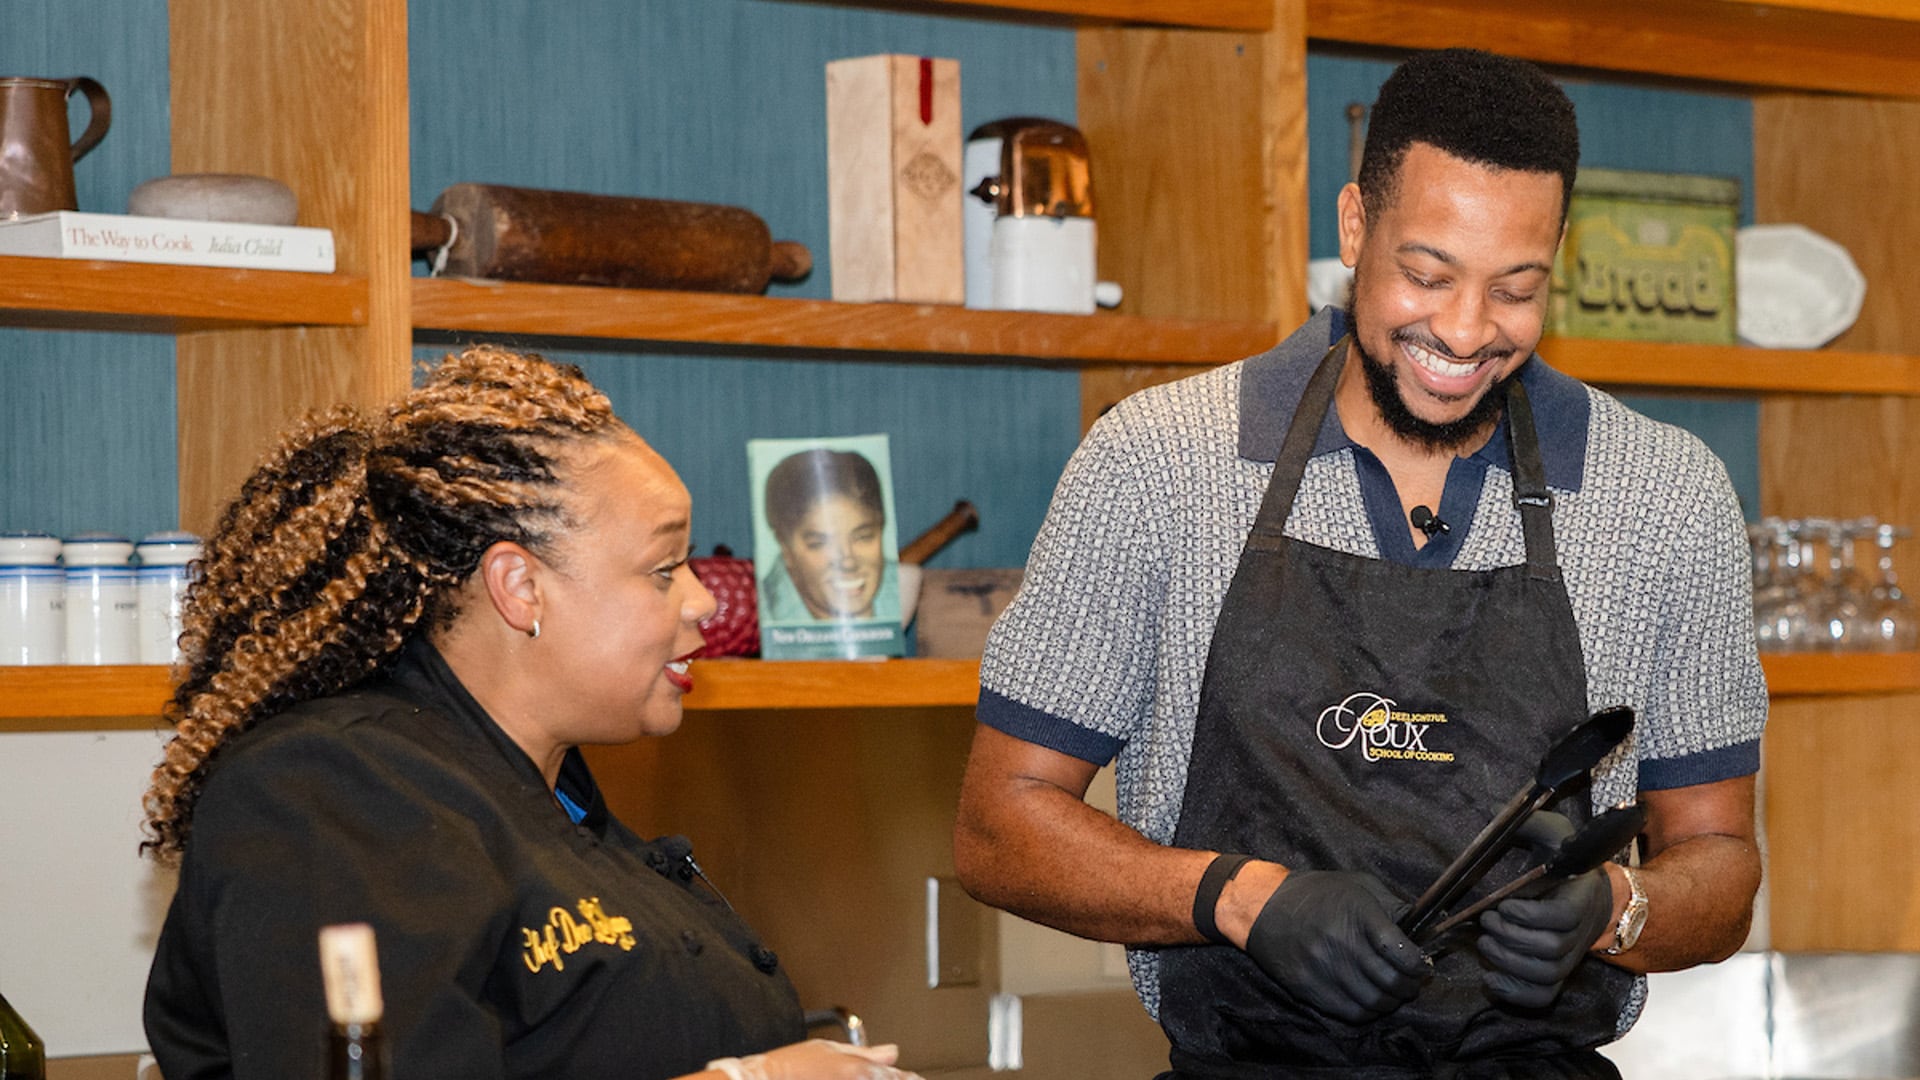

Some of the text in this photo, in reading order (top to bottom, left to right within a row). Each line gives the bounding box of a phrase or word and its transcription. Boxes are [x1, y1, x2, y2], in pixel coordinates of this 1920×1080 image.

[67, 228, 283, 257] The Way to Cook Julia Child
[1579, 255, 1720, 318] Bread
[1369, 747, 1455, 762] SCHOOL OF COOKING
[521, 923, 565, 974] Chef
